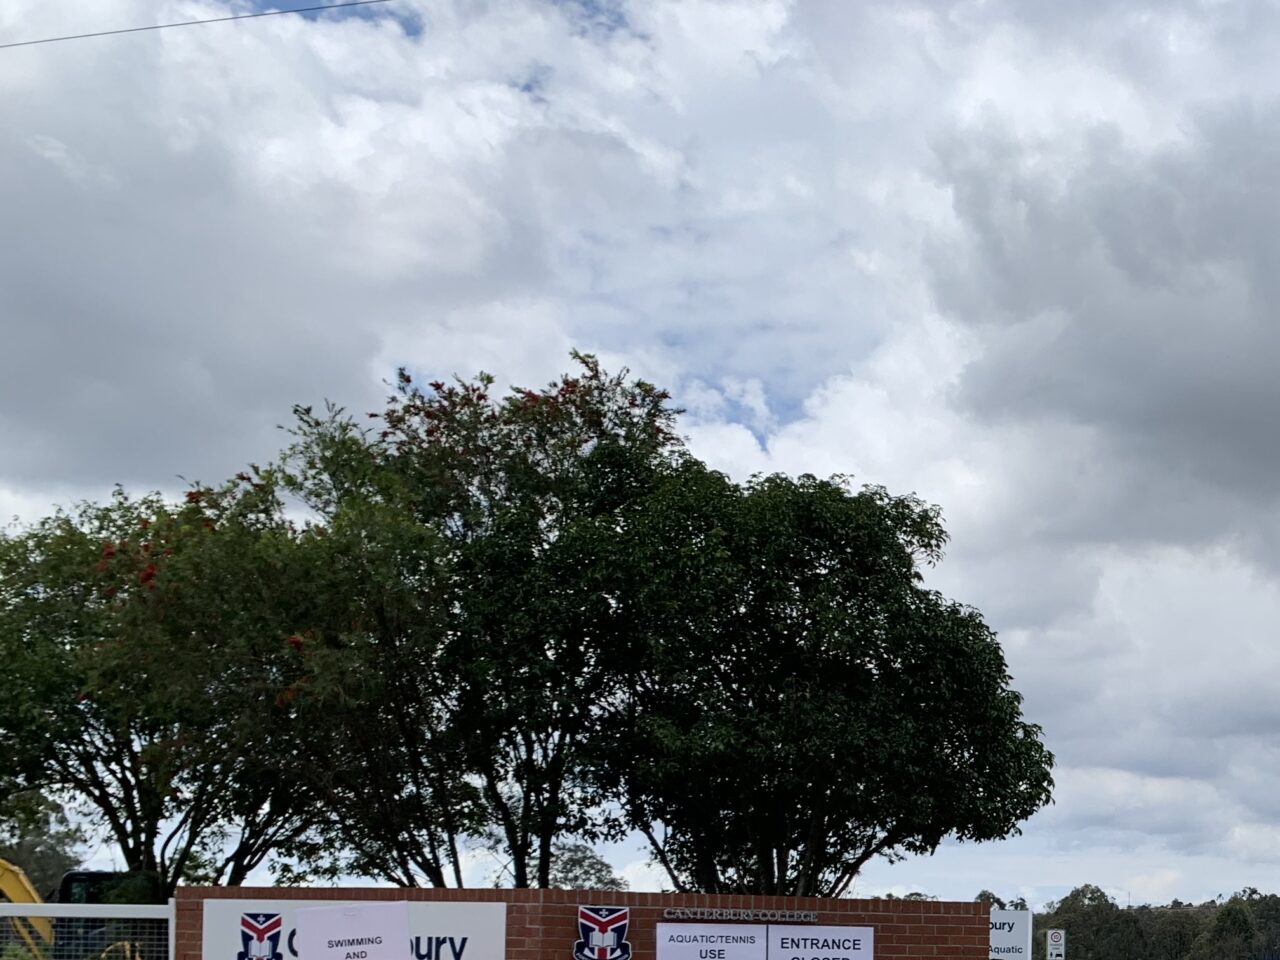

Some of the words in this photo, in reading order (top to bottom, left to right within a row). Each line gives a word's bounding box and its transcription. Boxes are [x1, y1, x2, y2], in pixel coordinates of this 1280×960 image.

[663, 907, 755, 921] CANTERBURY
[758, 910, 818, 922] COLLEGE
[327, 936, 383, 949] SWIMMING
[668, 934, 756, 944] AQUATIC/TENNIS
[780, 937, 862, 950] ENTRANCE
[345, 950, 368, 960] AND
[699, 949, 726, 959] USE
